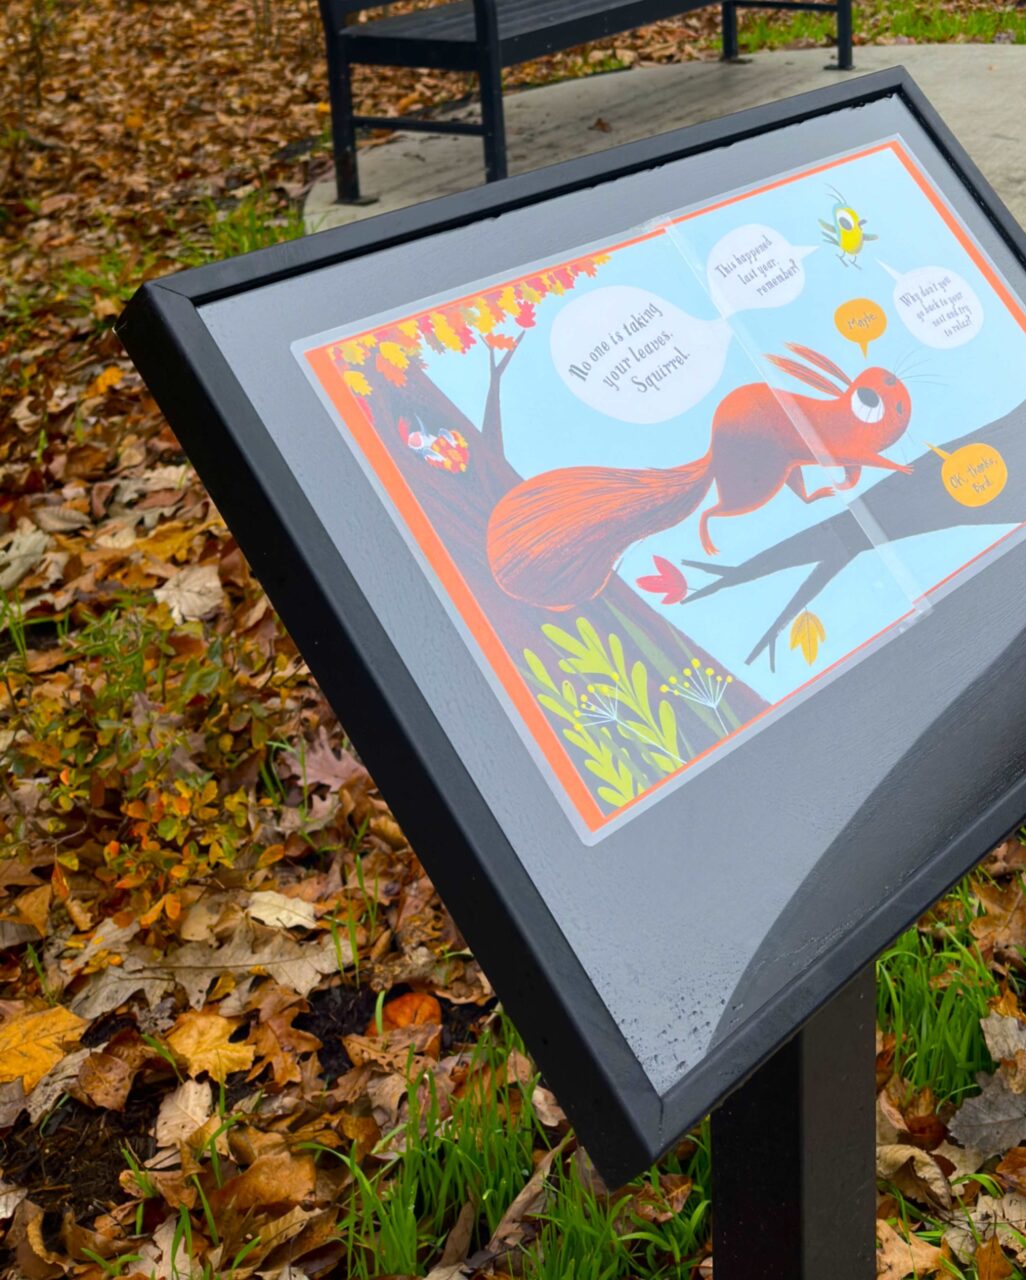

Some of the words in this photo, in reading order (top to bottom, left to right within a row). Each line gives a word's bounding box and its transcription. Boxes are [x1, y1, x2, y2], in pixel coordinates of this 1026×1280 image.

[714, 261, 737, 278] This
[732, 234, 773, 265] happened
[737, 268, 758, 285] last
[756, 258, 800, 296] remember?
[568, 360, 592, 382] No
[588, 341, 610, 362] one
[608, 330, 624, 346] is
[622, 302, 664, 336] taking
[602, 357, 631, 392] your
[630, 346, 690, 393] Squirrel.
